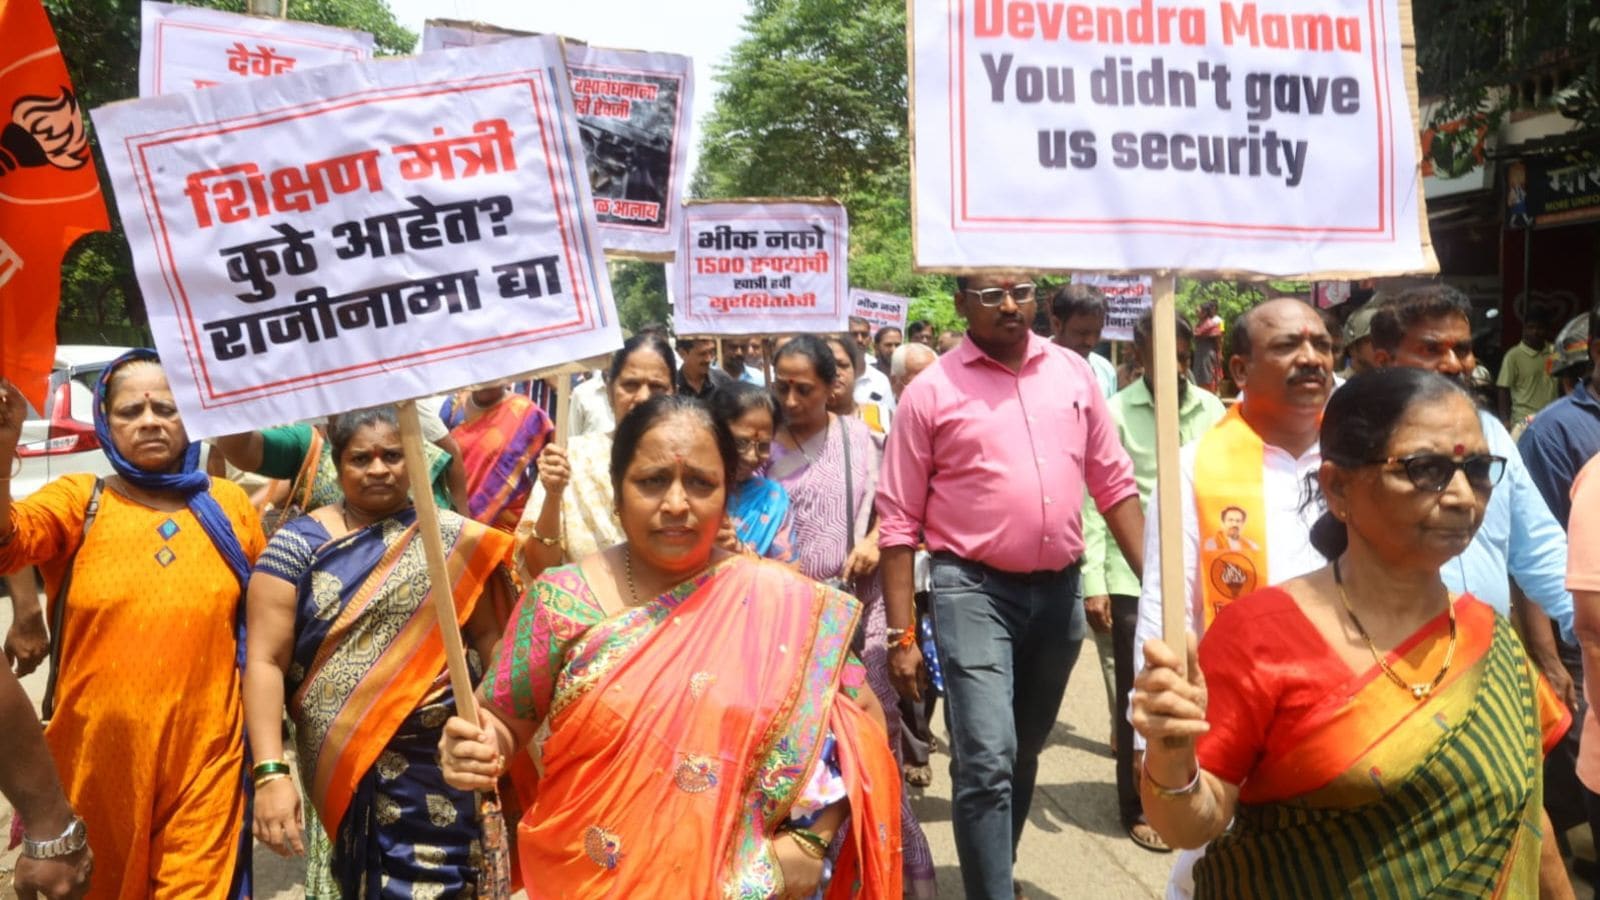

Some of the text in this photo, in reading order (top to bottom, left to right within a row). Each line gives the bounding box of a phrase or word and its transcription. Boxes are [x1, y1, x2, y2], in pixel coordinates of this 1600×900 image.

[973, 0, 1361, 53] Devendra Mama
[980, 52, 1361, 121] You didn't gave
[184, 117, 518, 229] शिक्षण मंत्री
[1037, 126, 1309, 188] us security
[613, 200, 658, 219] आलाय
[697, 224, 826, 250] भीक नको
[220, 194, 514, 304] कुठे आहेत?
[695, 256, 745, 274] 1500
[203, 254, 563, 361] राजीनामा द्या
